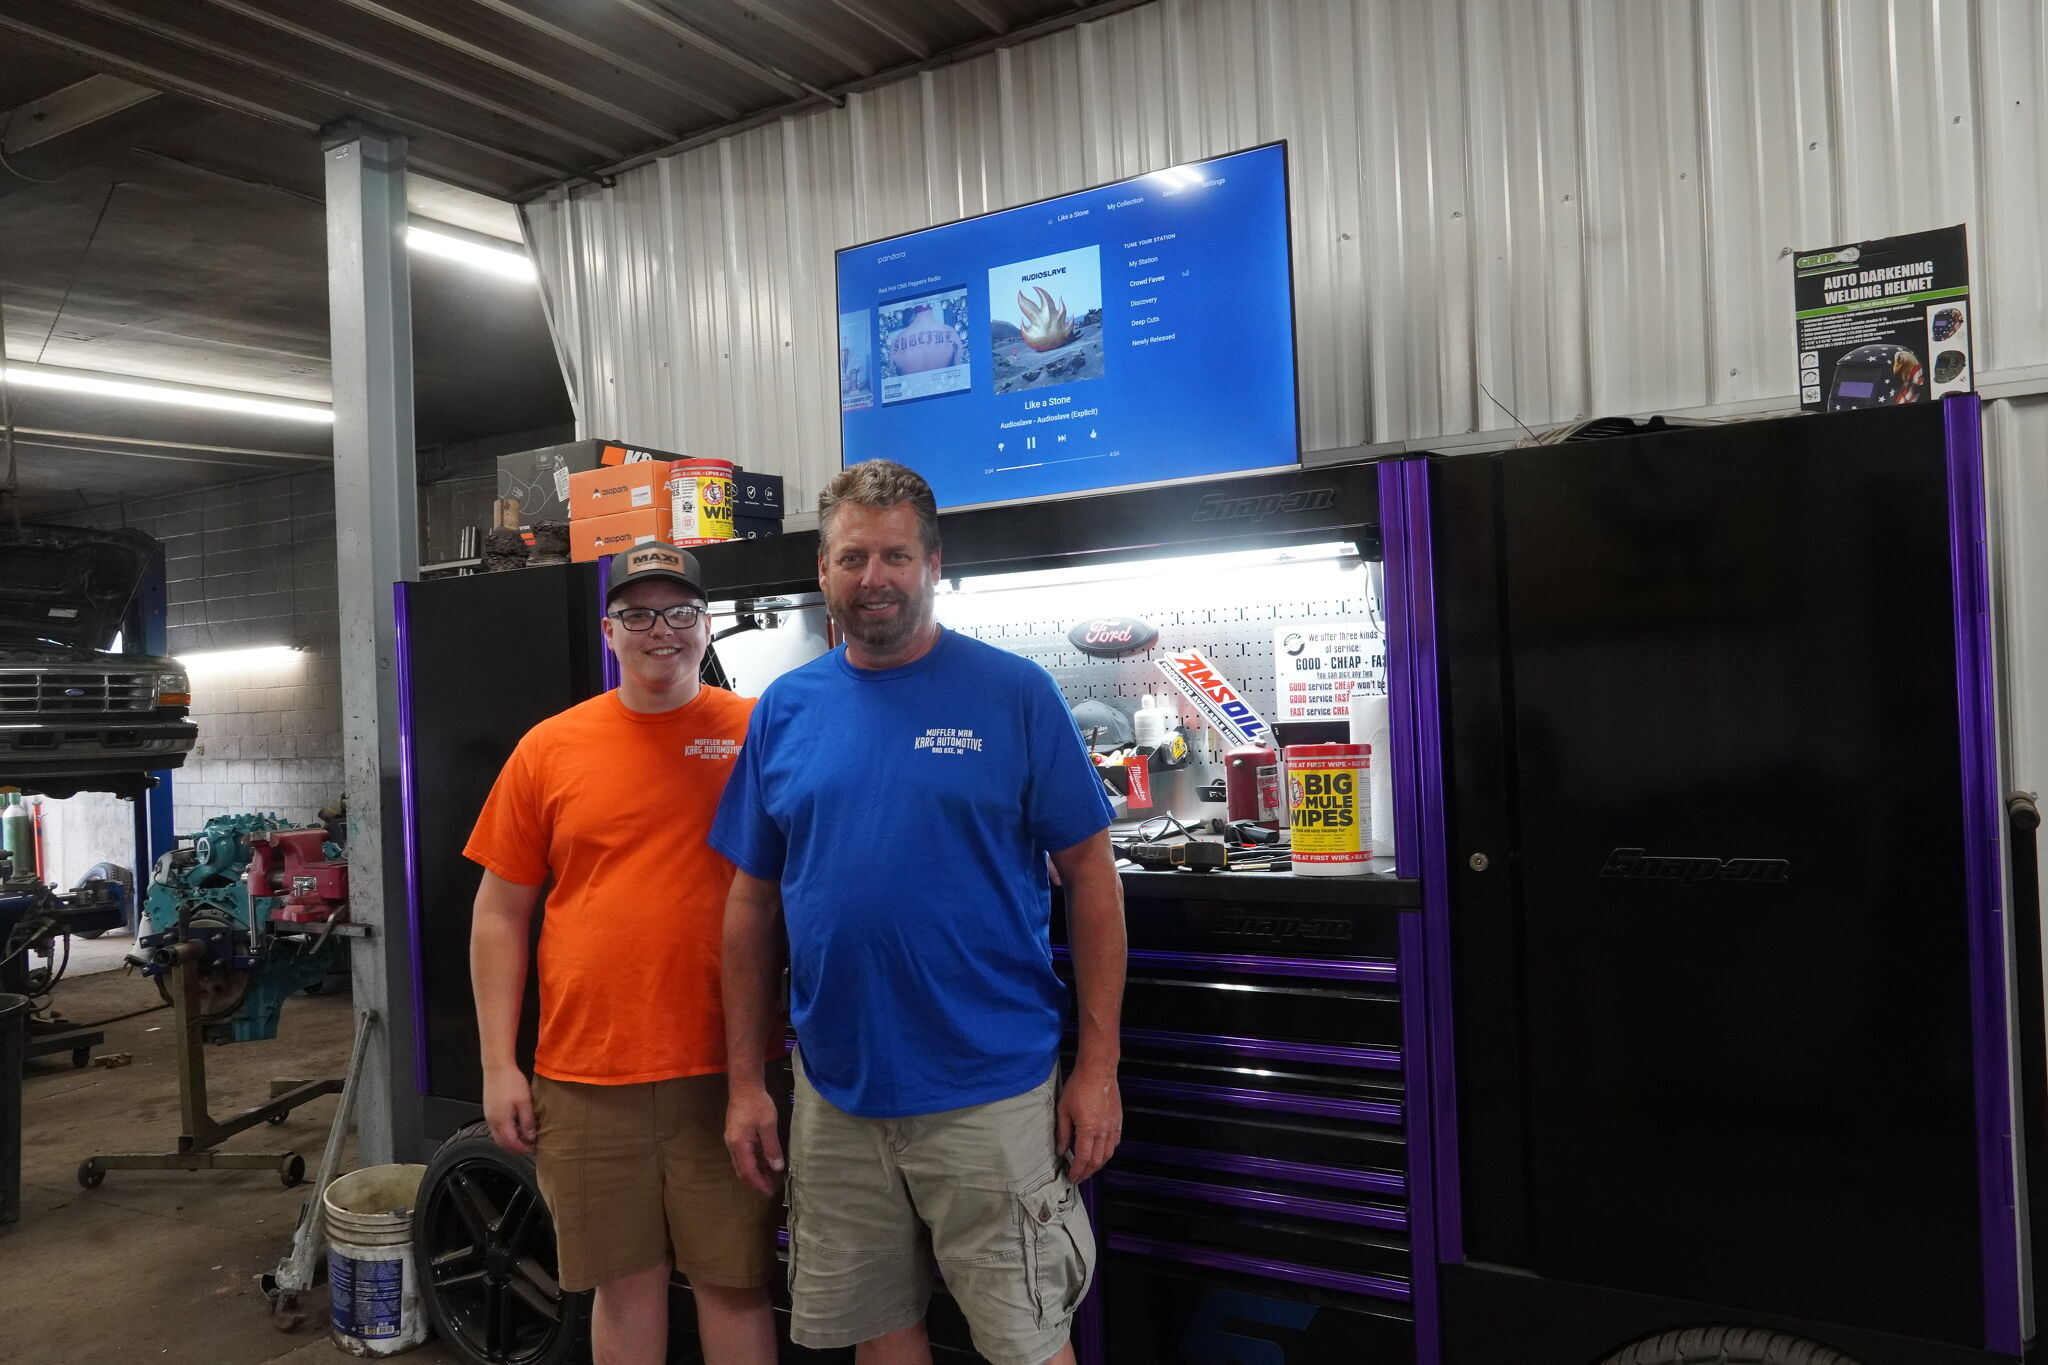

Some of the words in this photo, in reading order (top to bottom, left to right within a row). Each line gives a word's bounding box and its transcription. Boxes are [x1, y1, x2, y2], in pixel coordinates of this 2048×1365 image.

[1117, 197, 1144, 209] Collection
[1057, 214, 1068, 222] Like
[1073, 209, 1089, 218] Stone
[1139, 238, 1152, 246] YOUR
[1153, 233, 1176, 243] STATION
[877, 251, 906, 264] pandora
[1129, 260, 1138, 268] My
[1138, 256, 1158, 266] Station
[1021, 267, 1066, 282] AUDIOSLAVE
[1129, 277, 1147, 287] Crowd
[1148, 275, 1165, 284] Faves
[1824, 273, 1857, 290] AUTO
[1860, 261, 1933, 284] DARKENING
[908, 279, 927, 288] Peppers
[927, 275, 942, 283] Radio
[1824, 285, 1881, 305] WELDING
[1884, 276, 1933, 296] HELMET
[1130, 296, 1158, 307] Discovery
[1131, 319, 1146, 327] Deep
[1146, 316, 1160, 324] Cuts
[1132, 337, 1149, 347] Newly
[1150, 333, 1176, 343] Released
[1024, 400, 1040, 410] Like
[1048, 396, 1071, 406] Stone
[1000, 419, 1032, 429] Audioslave
[1037, 413, 1070, 423] Audioslave
[1071, 408, 1098, 420] (Explicit)
[703, 505, 733, 520] WIP
[633, 553, 679, 564] MAXI
[1085, 621, 1132, 643] Ford
[1309, 633, 1318, 642] We
[1321, 632, 1337, 641] offer
[1339, 632, 1358, 641] three
[1360, 630, 1378, 639] kinds
[1325, 645, 1332, 653] of
[1296, 657, 1321, 670] GOOD
[1331, 655, 1361, 669] CHEAP
[1371, 654, 1386, 668] FA
[1352, 671, 1361, 679] any
[1289, 682, 1306, 692] GOOD
[1308, 682, 1332, 690] service
[1334, 681, 1355, 690] CHEAP
[1357, 680, 1375, 689] won't
[1161, 661, 1194, 695] PRODUCTS
[1191, 694, 1226, 730] AVAILABLE
[1174, 653, 1264, 738] AMSOIL
[1289, 694, 1307, 703] GOOD
[1309, 694, 1333, 703] service
[1334, 693, 1350, 702] FAST
[1290, 707, 1305, 717] FAST
[1306, 707, 1331, 716] service
[1332, 706, 1349, 716] CHEA
[926, 728, 956, 737] MUFFLER
[957, 729, 973, 738] MAN
[684, 745, 703, 757] KARG
[704, 745, 743, 755] AUTOMOTIV
[914, 737, 935, 749] KARG
[936, 737, 983, 752] AUTOMOTIVE
[1131, 764, 1146, 801] Milwaukee
[1305, 773, 1352, 795] BIG
[1305, 795, 1353, 809] MULE
[1290, 809, 1353, 827] WIPES
